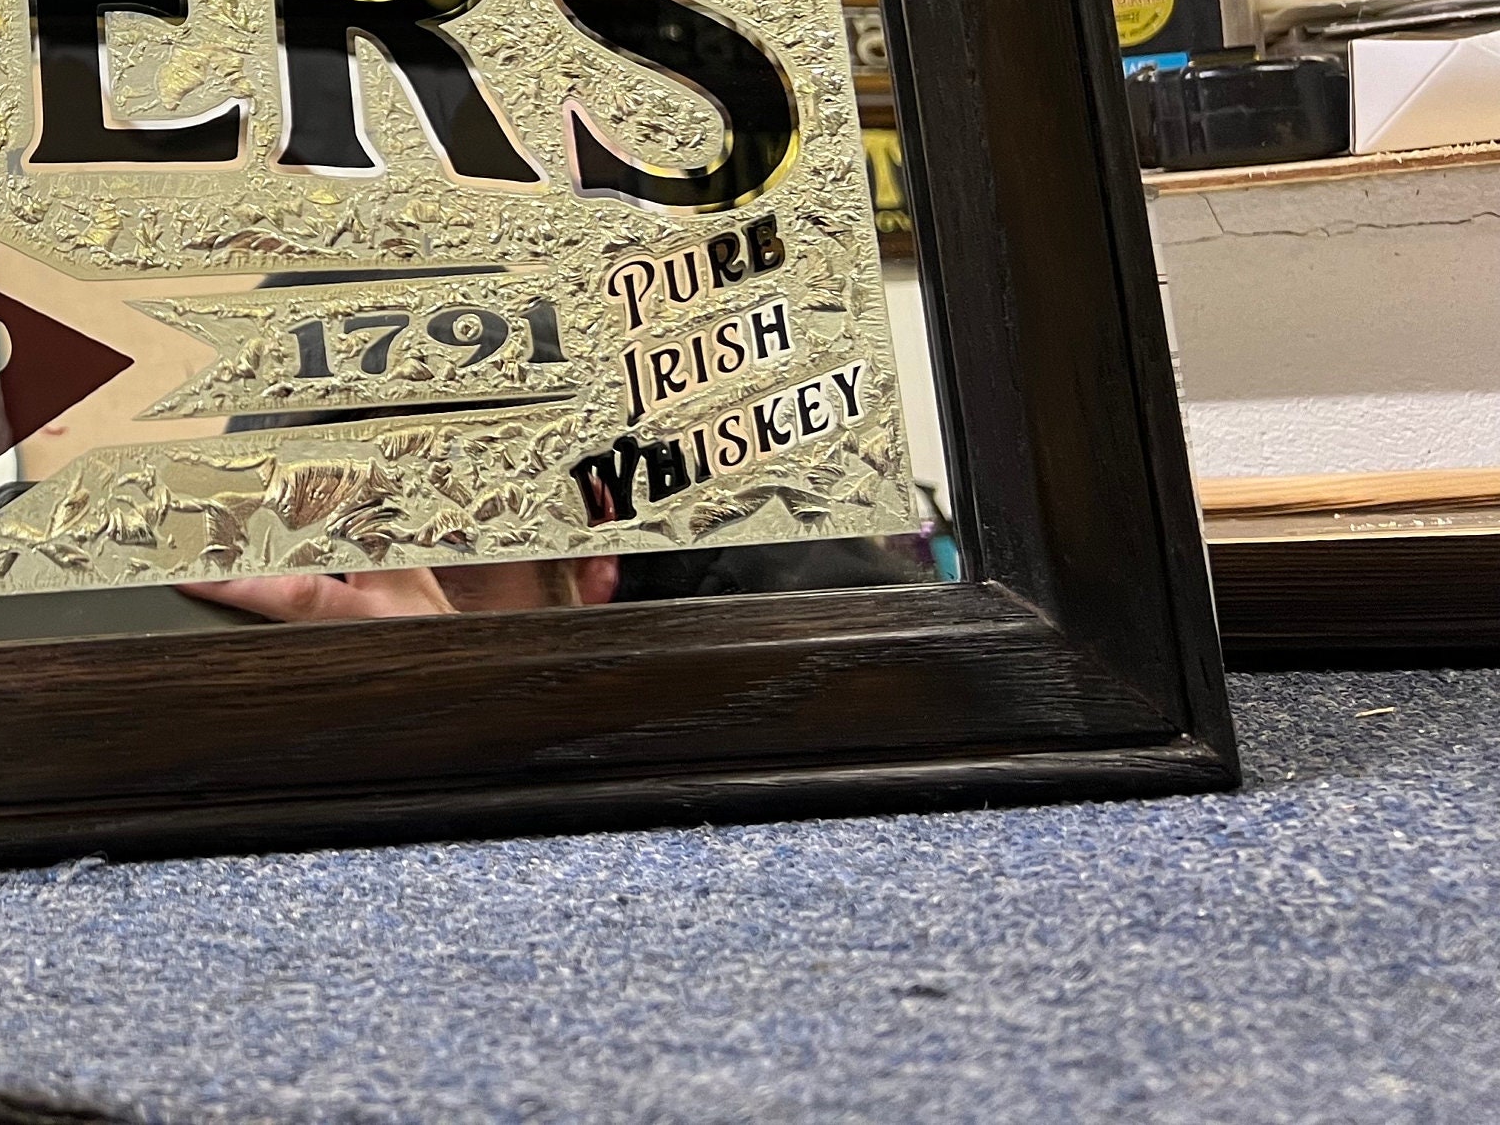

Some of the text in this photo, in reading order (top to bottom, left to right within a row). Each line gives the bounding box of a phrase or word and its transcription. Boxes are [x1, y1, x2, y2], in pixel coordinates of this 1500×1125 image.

[605, 213, 787, 330] PURE
[288, 295, 570, 379] 1791
[620, 296, 797, 426] IRISH
[569, 357, 870, 528] WHISKEY
